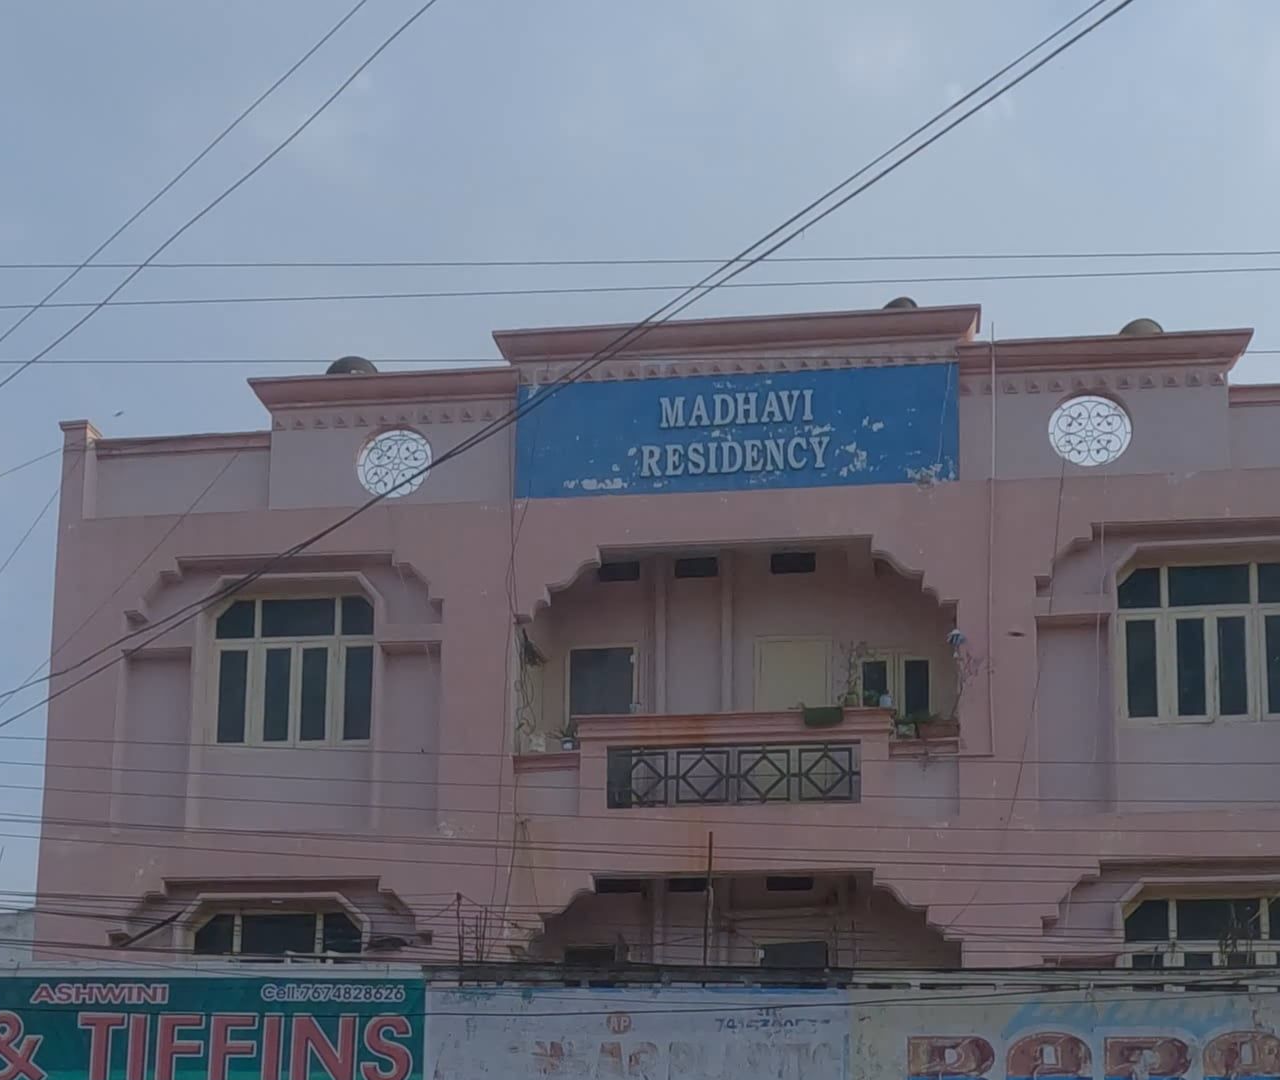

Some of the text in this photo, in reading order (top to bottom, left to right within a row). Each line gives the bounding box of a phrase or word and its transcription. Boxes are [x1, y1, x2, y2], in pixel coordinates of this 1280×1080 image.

[659, 389, 814, 428] MADHAVI
[639, 436, 831, 477] RESIDENCY
[28, 983, 169, 1005] ASHWINI
